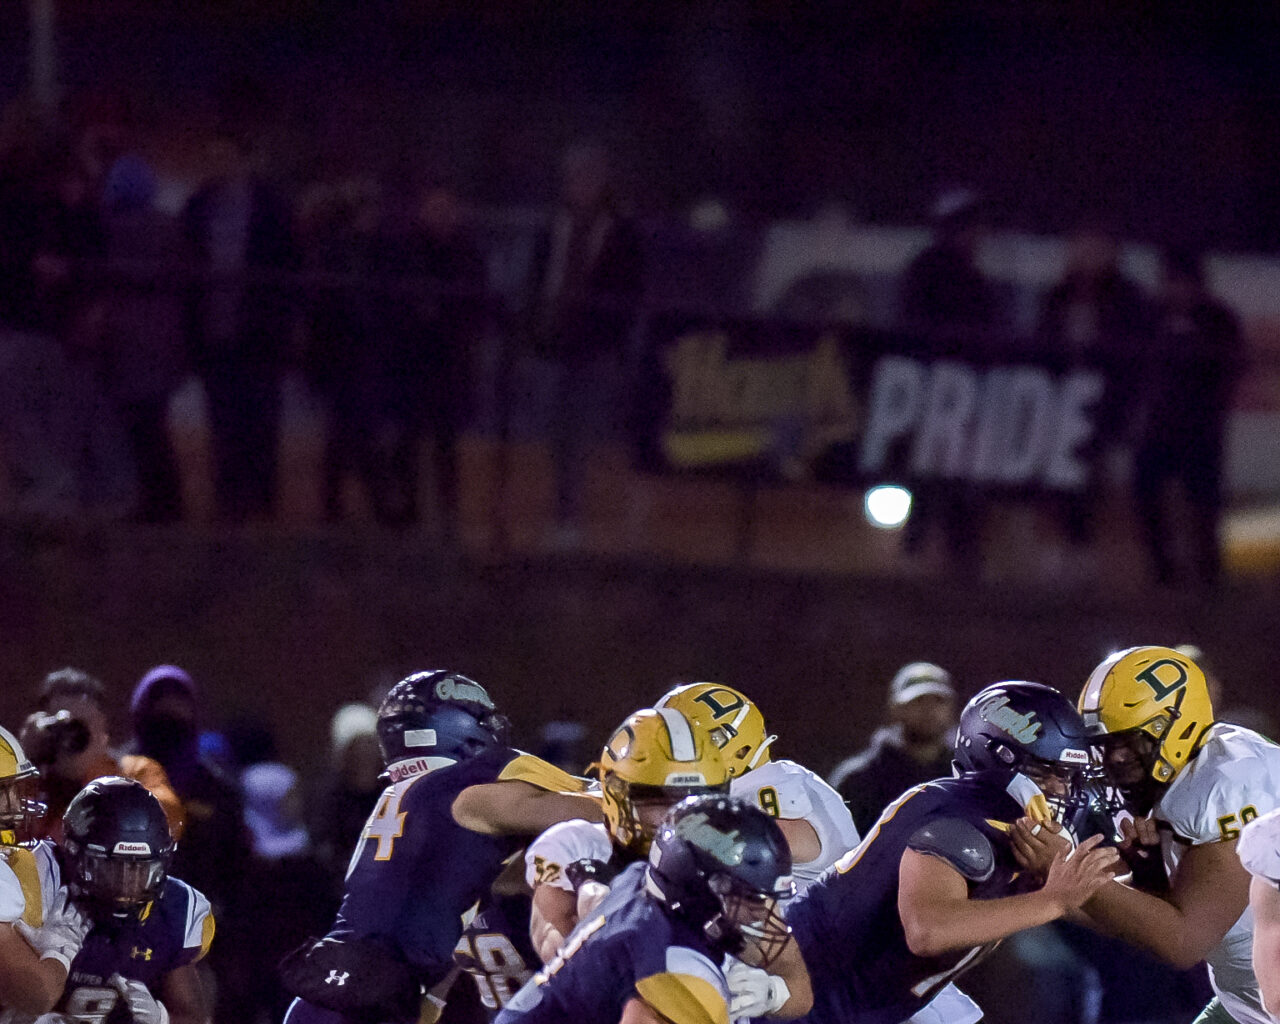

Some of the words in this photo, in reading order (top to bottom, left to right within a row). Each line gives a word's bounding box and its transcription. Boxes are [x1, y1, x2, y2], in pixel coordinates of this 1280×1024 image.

[857, 356, 1104, 488] PRIDE
[1134, 658, 1188, 702] D
[693, 687, 746, 721] D
[391, 759, 429, 781] ddell
[364, 779, 416, 861] 4
